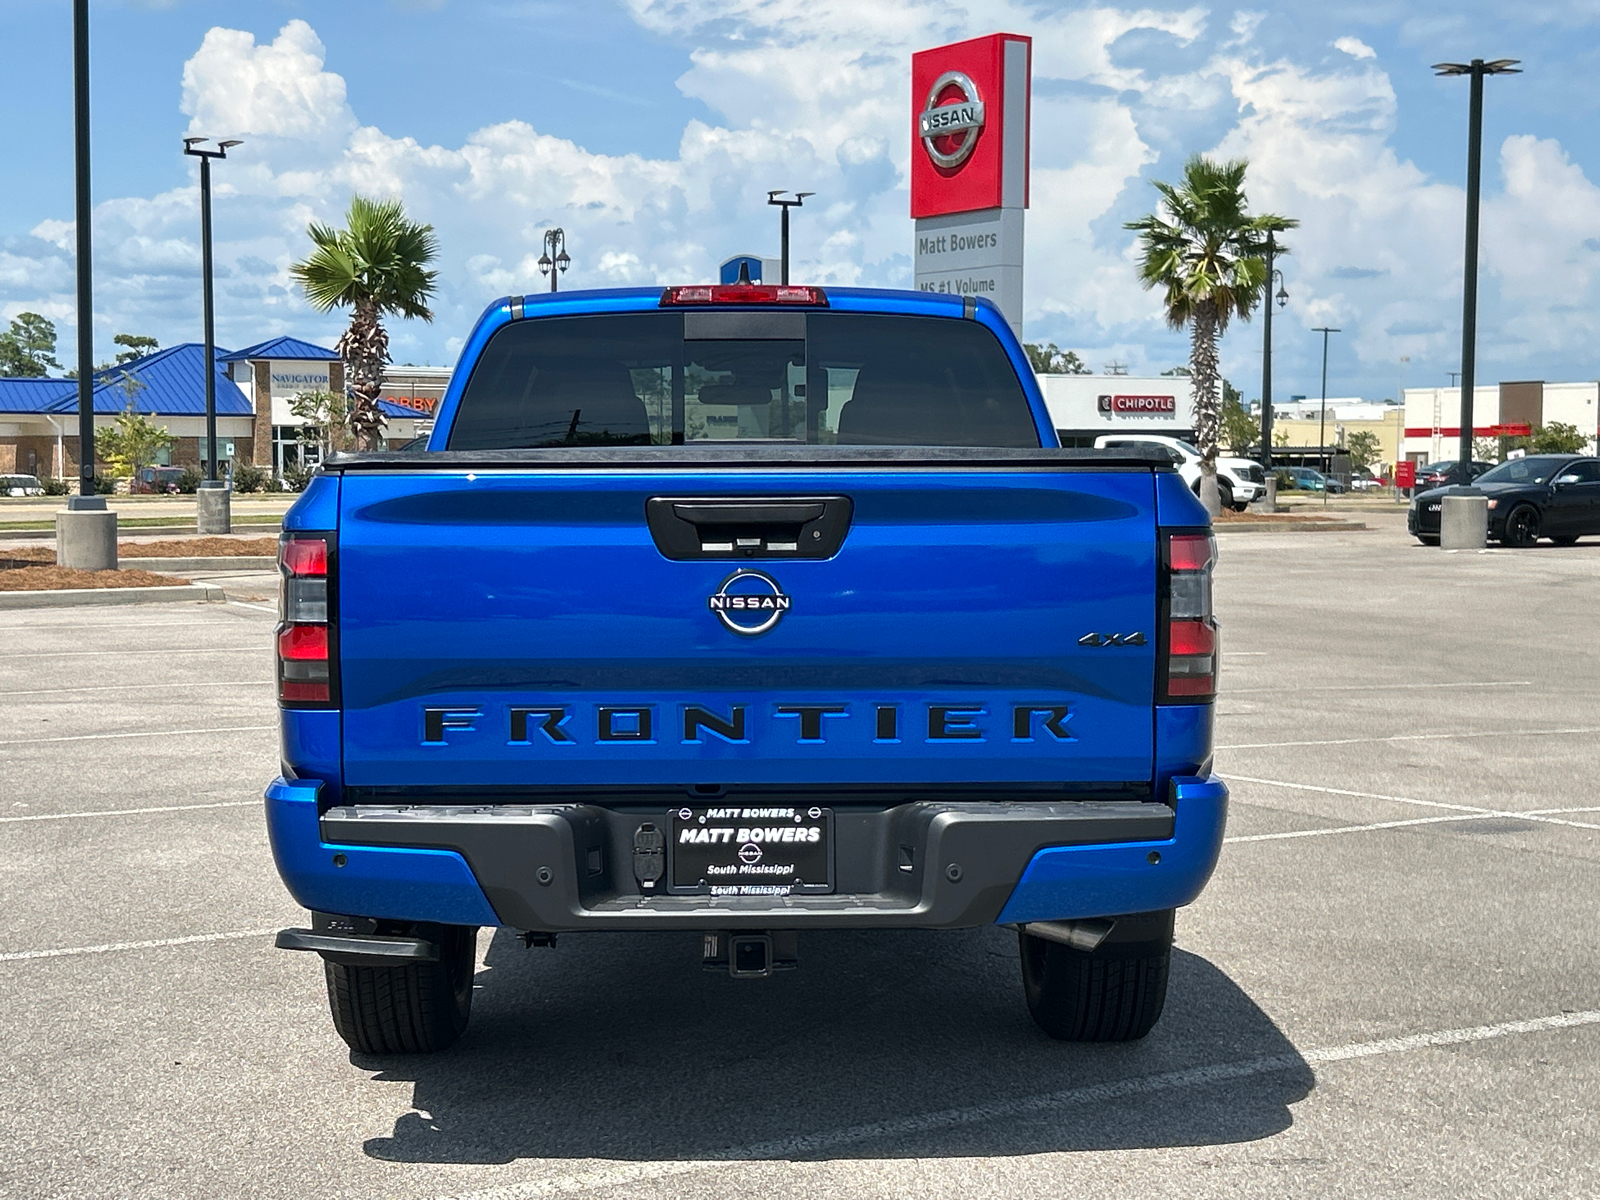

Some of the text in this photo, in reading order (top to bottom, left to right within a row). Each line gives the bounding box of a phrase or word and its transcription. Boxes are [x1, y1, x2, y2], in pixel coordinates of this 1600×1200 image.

[922, 107, 974, 132] ISSAN
[919, 233, 997, 255] Matt Bowers
[920, 277, 996, 294] MS #1 Volume
[272, 374, 329, 384] NAVIGATOR
[379, 396, 437, 411] BBY
[1117, 398, 1174, 409] CHIPOTLE
[710, 597, 790, 608] NISSAN
[421, 704, 1077, 746] FRONTIER
[706, 808, 795, 819] MATT BOWERS
[679, 827, 821, 844] MATT BOWERS
[707, 863, 795, 875] South Mississippi
[710, 885, 791, 895] South Mississippi
